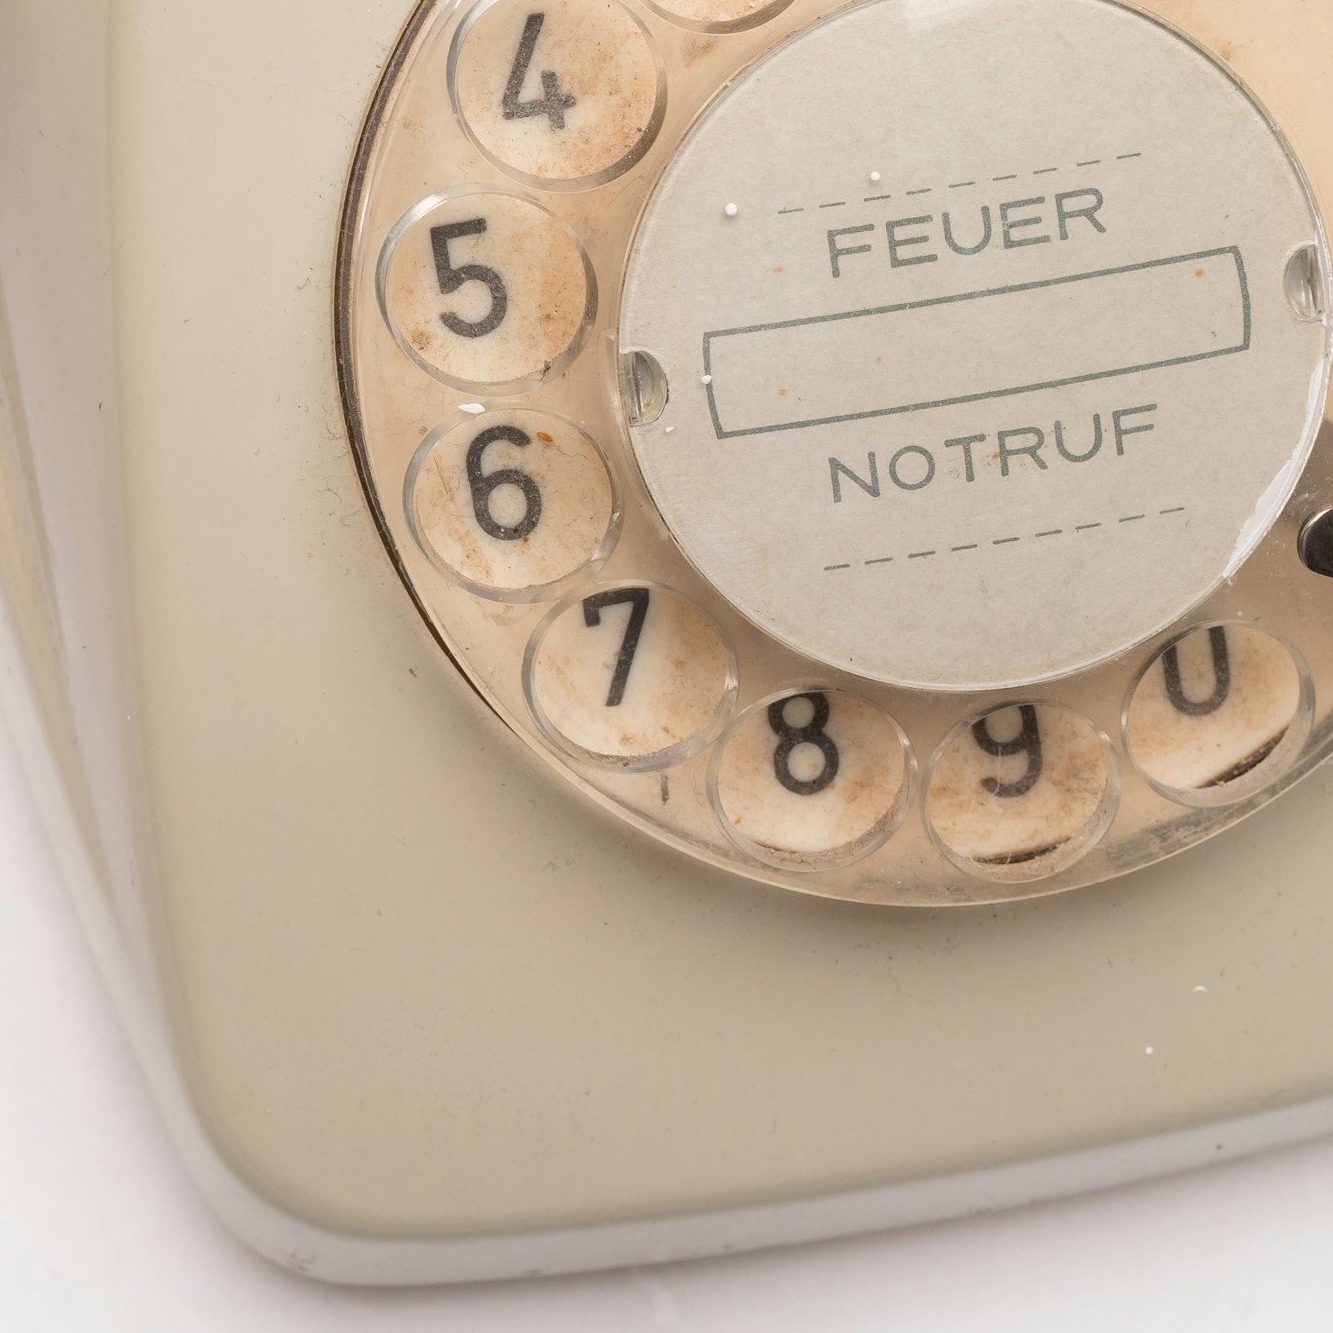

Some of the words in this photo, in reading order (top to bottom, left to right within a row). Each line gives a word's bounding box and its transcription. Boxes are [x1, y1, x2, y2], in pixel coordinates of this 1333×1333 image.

[503, 12, 576, 130] 4
[430, 217, 508, 338] 5
[827, 186, 1107, 278] FEUER
[467, 425, 542, 541] 6
[829, 403, 1157, 503] NOTRUF
[581, 587, 650, 707] 7
[767, 690, 840, 796] 8
[971, 702, 1043, 797] 9
